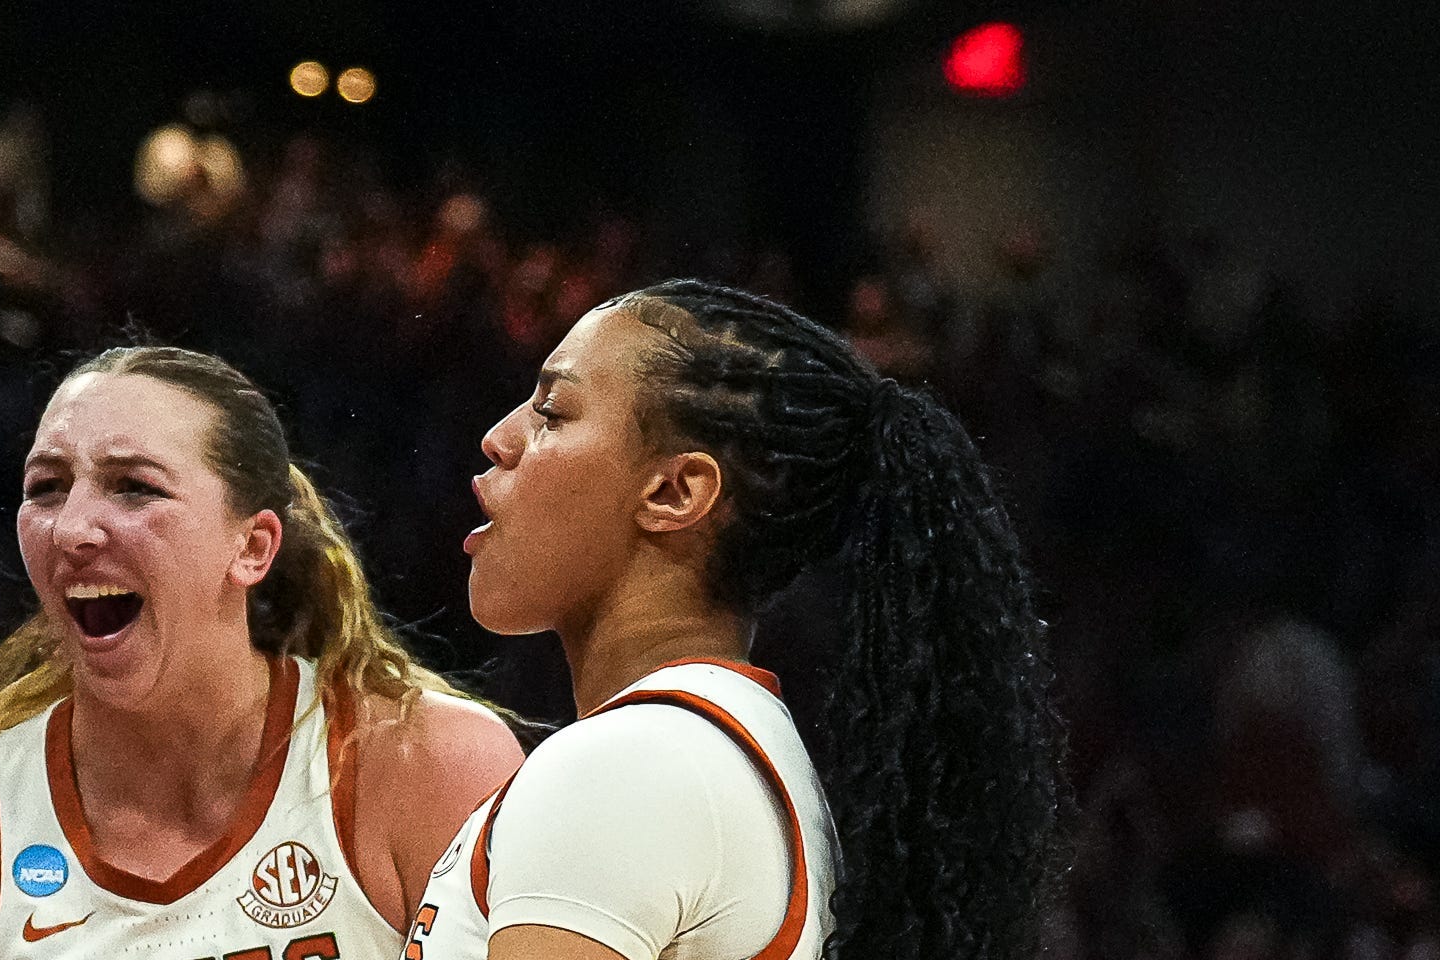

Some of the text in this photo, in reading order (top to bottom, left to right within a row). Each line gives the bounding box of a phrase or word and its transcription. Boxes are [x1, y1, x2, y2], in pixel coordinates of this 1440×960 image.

[20, 867, 64, 884] NCAA
[256, 845, 318, 904] SEC
[251, 890, 328, 926] GRADUATE
